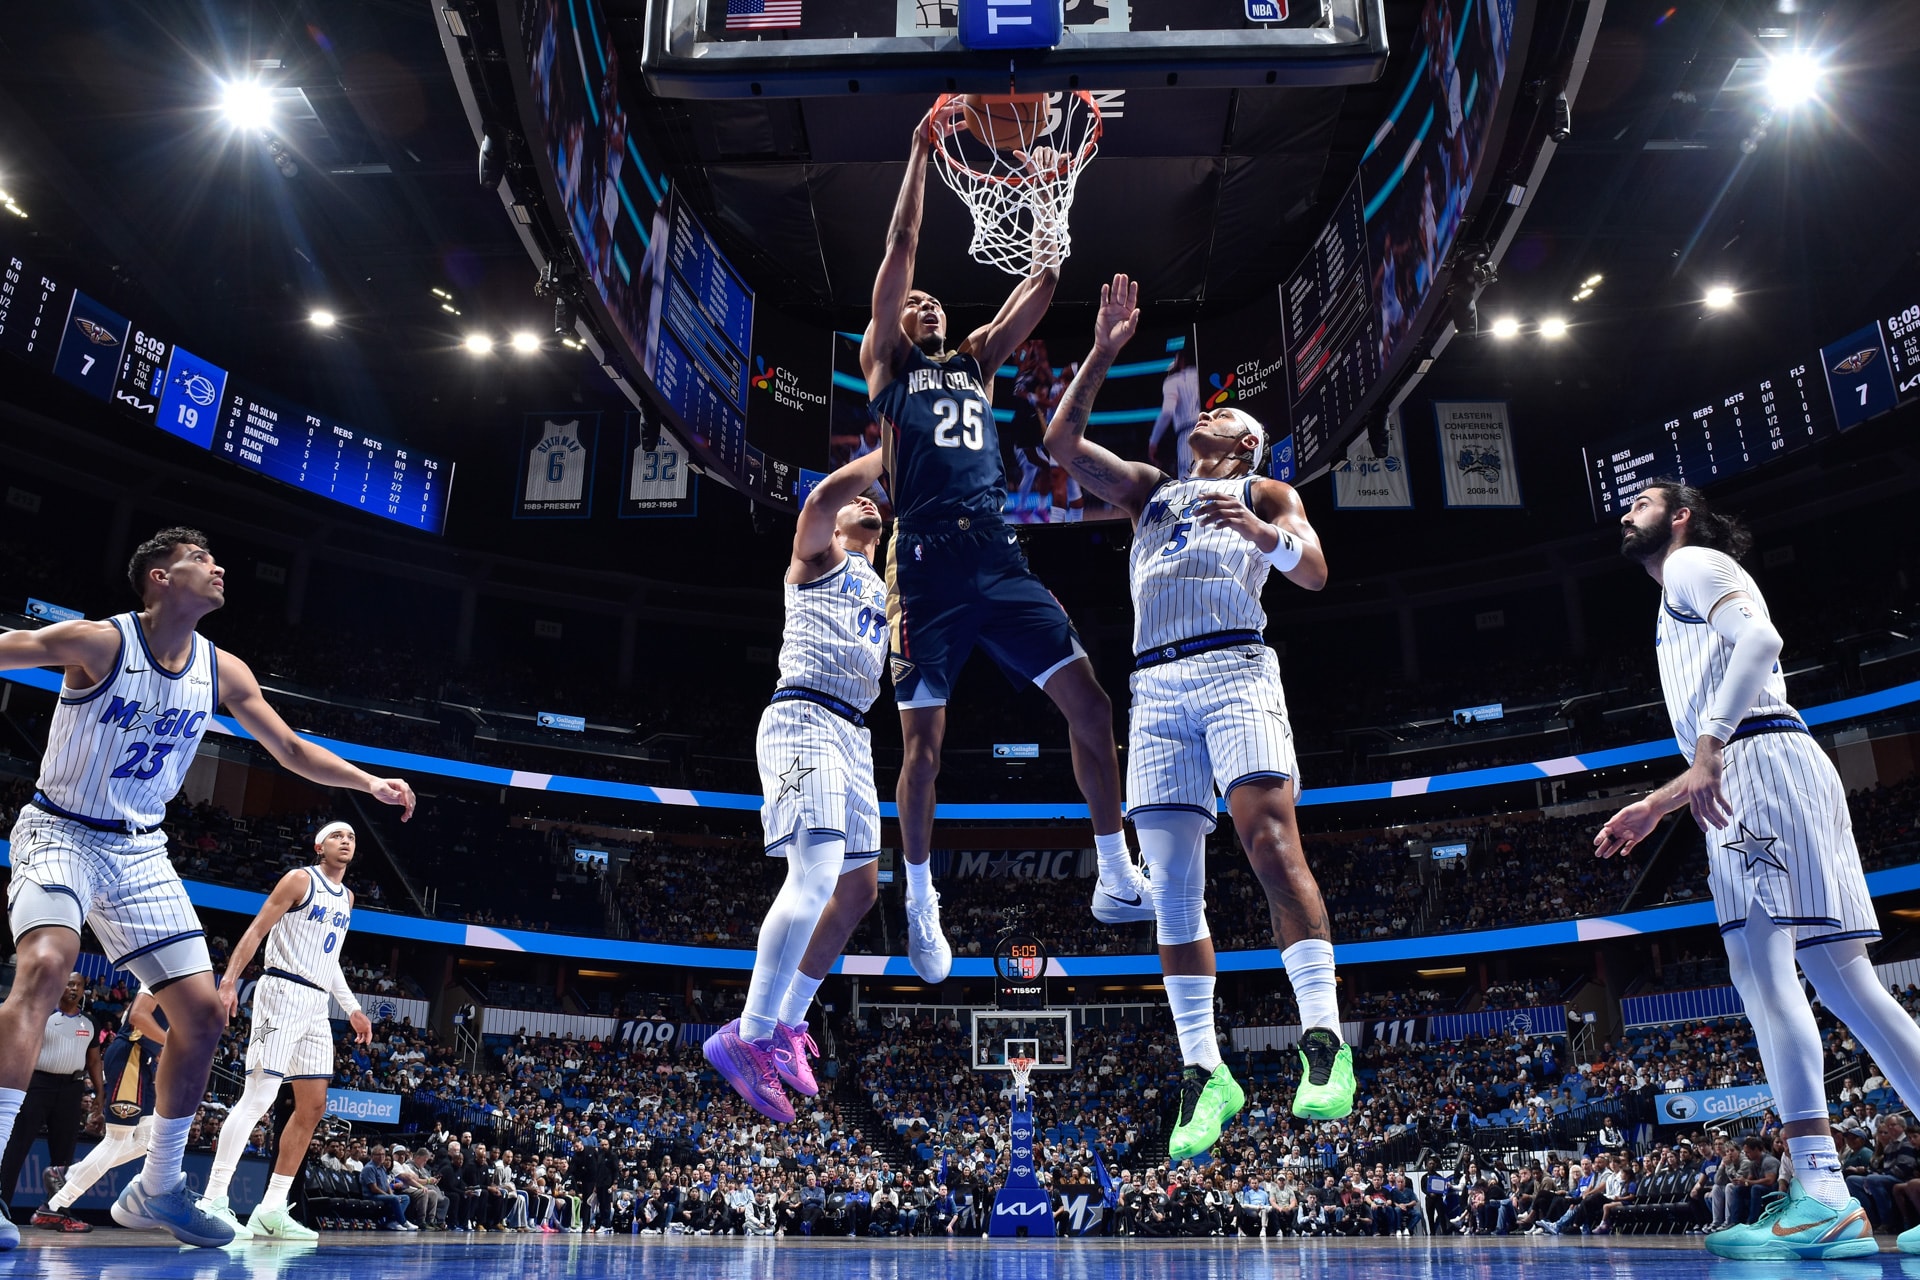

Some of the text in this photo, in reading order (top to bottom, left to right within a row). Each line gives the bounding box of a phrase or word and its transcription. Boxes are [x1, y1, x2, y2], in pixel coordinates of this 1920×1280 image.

[1252, 4, 1273, 17] NBA
[5, 269, 48, 302] 0/0 0
[10, 257, 57, 293] FG FLS
[2, 283, 15, 296] 0/1
[34, 317, 41, 326] 0
[1887, 304, 1920, 332] 6:09
[30, 330, 37, 340] 0
[134, 330, 166, 356] 6:09
[1892, 328, 1905, 339] 1ST
[1903, 336, 1917, 348] FLS
[27, 342, 34, 352] 0
[134, 345, 161, 364] 1ST QTR
[1905, 346, 1920, 357] TOL
[80, 354, 96, 377] 7
[136, 370, 149, 382] TOL
[138, 361, 151, 373] FLS
[776, 366, 798, 386] City
[1236, 359, 1260, 376] City
[1237, 356, 1283, 388] National
[133, 378, 147, 390] CHL
[775, 378, 826, 405] National
[908, 368, 944, 395] NEW
[1238, 381, 1268, 401] Bank
[774, 391, 804, 412] Bank
[1664, 364, 1806, 432] PTS REBS ASTS FG FLS
[1855, 383, 1868, 406] 7
[177, 404, 199, 429] 19
[933, 398, 984, 451] 25
[1445, 422, 1503, 430] CONFERENCE
[234, 395, 244, 406] 23
[250, 402, 259, 414] DA
[259, 406, 278, 422] SILVA
[394, 460, 406, 471] 0/0
[1596, 458, 1605, 468] 21
[1612, 449, 1631, 463] MISSI
[1761, 391, 1774, 404] 0/0
[1614, 452, 1655, 474] WILLIAMSON
[1764, 402, 1776, 415] 0/1
[232, 407, 242, 418] 35
[393, 471, 404, 482] 1/2
[306, 414, 438, 470] PTS REBS ASTS FG FLS
[537, 436, 580, 453] SIXTH MAN
[1616, 470, 1636, 485] FEARS
[1767, 414, 1779, 426] 1/2
[1771, 438, 1785, 450] 0/0
[242, 437, 264, 454] BLACK
[389, 492, 400, 504] 2/2
[244, 426, 279, 447] BANCHERO
[391, 482, 402, 493] 2/2
[546, 451, 566, 483] 6
[643, 450, 678, 482] 32
[773, 461, 788, 473] 6:09
[1602, 492, 1612, 502] 25
[1617, 479, 1646, 496] MURPHY
[1769, 426, 1781, 438] 1/2
[224, 442, 234, 454] 93
[240, 448, 262, 465] PENDA
[388, 504, 397, 515] 1/1
[748, 474, 755, 486] 7
[1280, 466, 1290, 481] 19
[1161, 522, 1192, 557] 5
[856, 606, 886, 644] 93
[189, 675, 210, 688] Disney
[110, 742, 175, 780] 23
[324, 932, 336, 954] 0
[1011, 944, 1037, 957] 6:09
[622, 1021, 674, 1048] 109
[1374, 1020, 1415, 1047] 111
[1704, 1092, 1776, 1114] Gallagh
